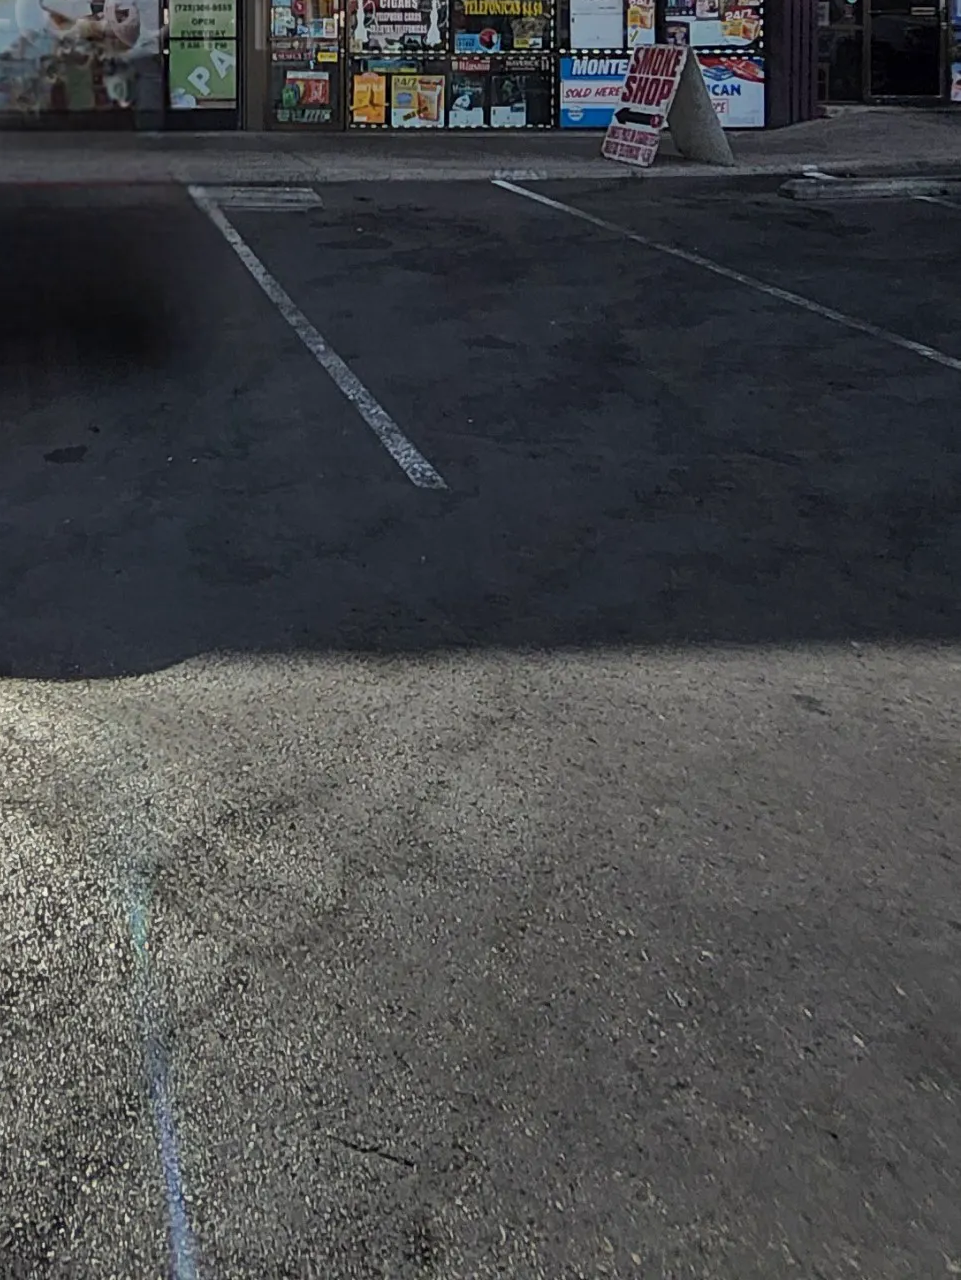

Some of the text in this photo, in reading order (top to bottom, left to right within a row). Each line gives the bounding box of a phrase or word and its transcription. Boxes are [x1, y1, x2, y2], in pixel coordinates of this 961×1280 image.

[629, 45, 683, 78] SMOKE
[565, 86, 621, 99] SOLD HERE
[621, 75, 675, 108] SHOP
